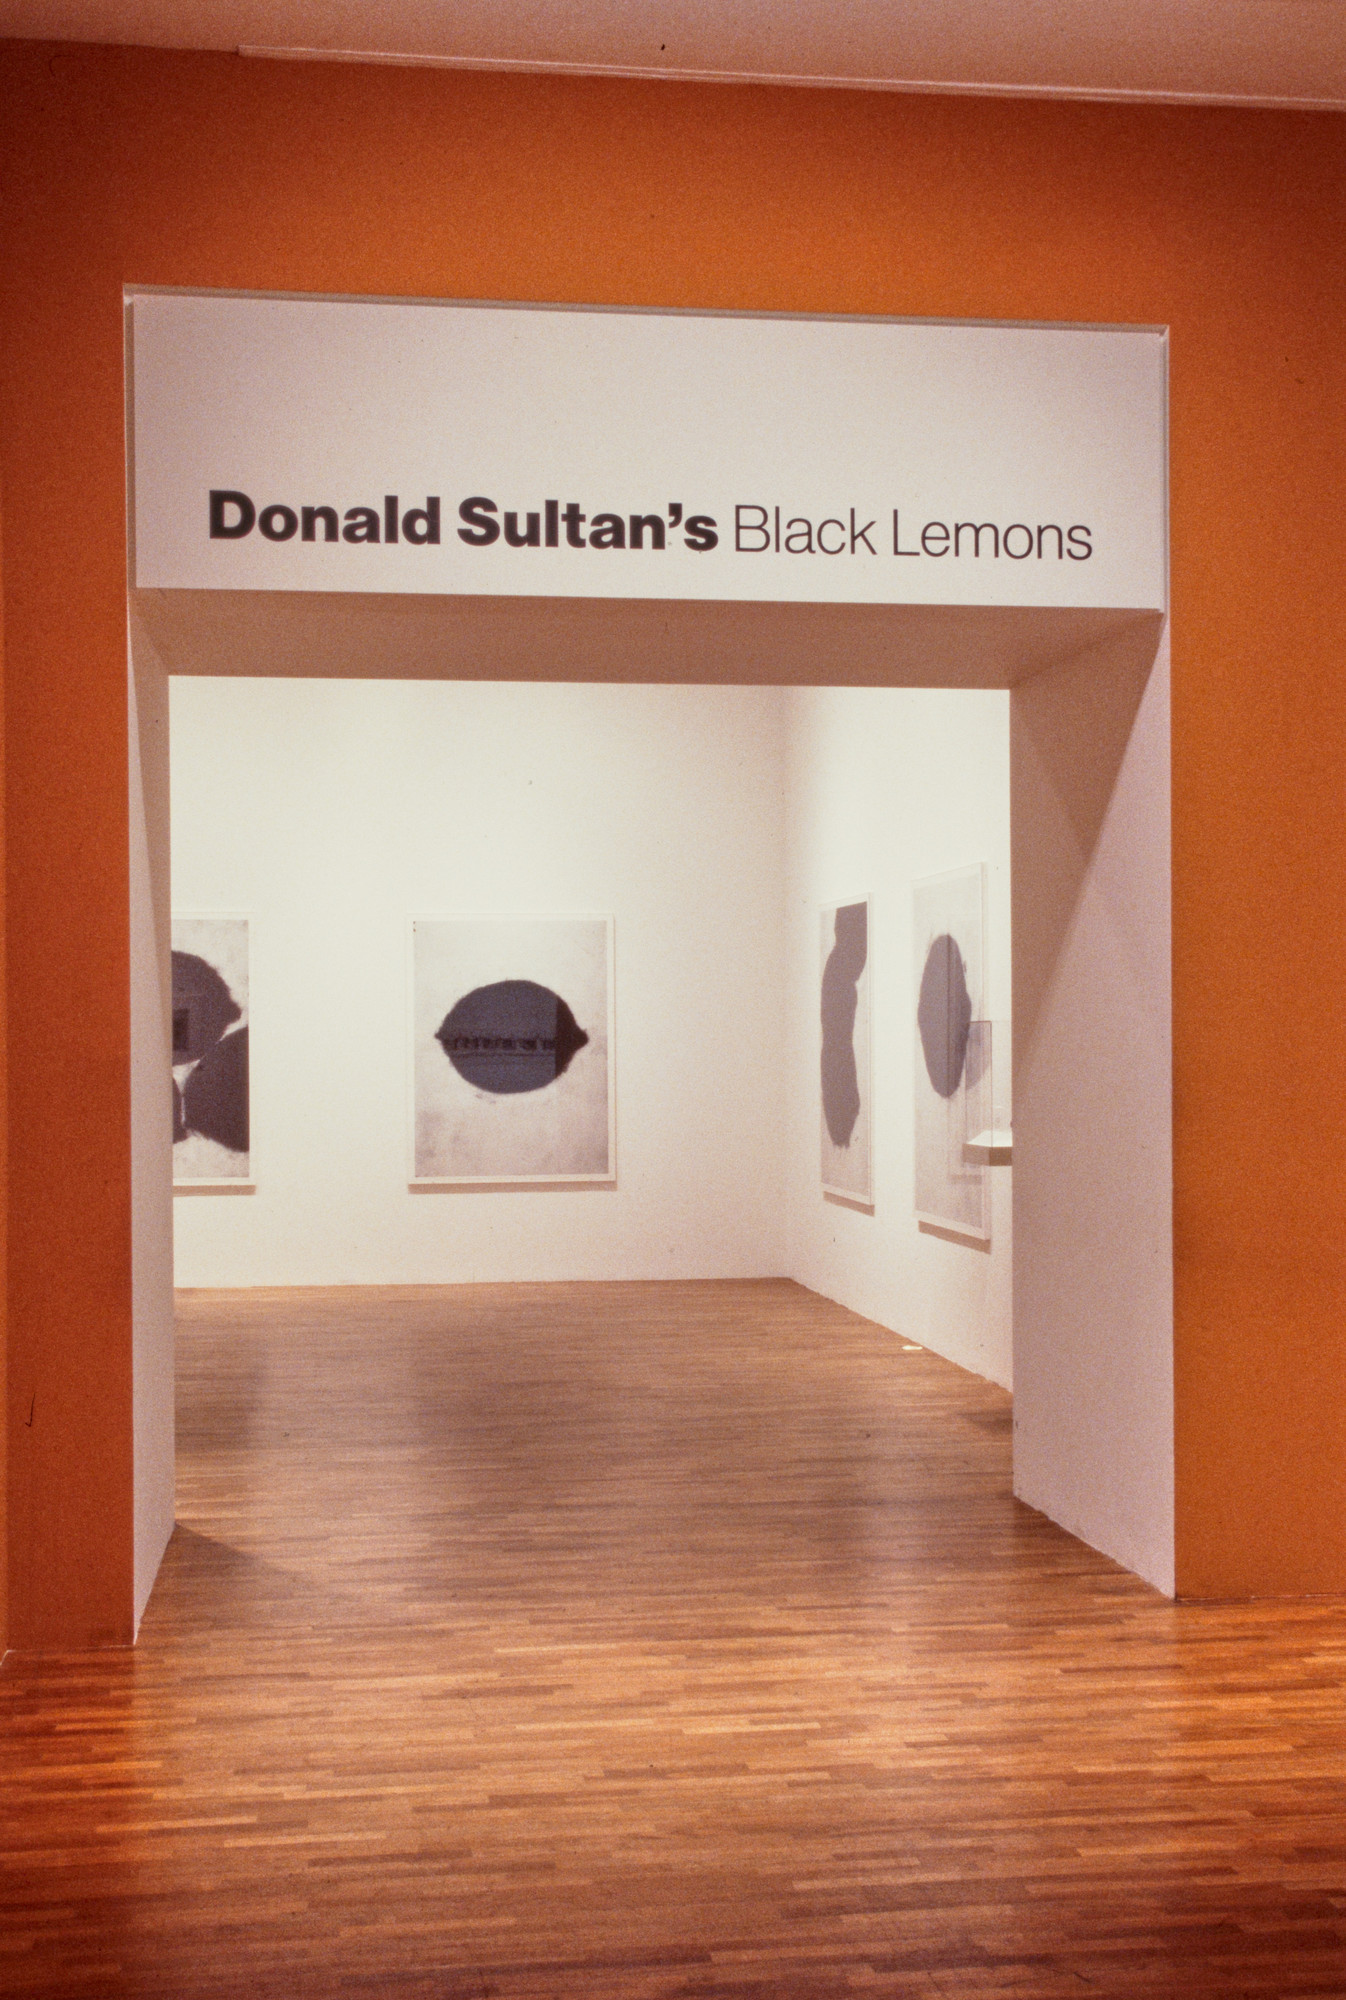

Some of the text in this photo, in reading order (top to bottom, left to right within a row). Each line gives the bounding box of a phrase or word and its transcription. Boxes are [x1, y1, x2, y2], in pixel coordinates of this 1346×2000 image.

[208, 489, 1093, 561] Donald Sultan’s Black Lemons
